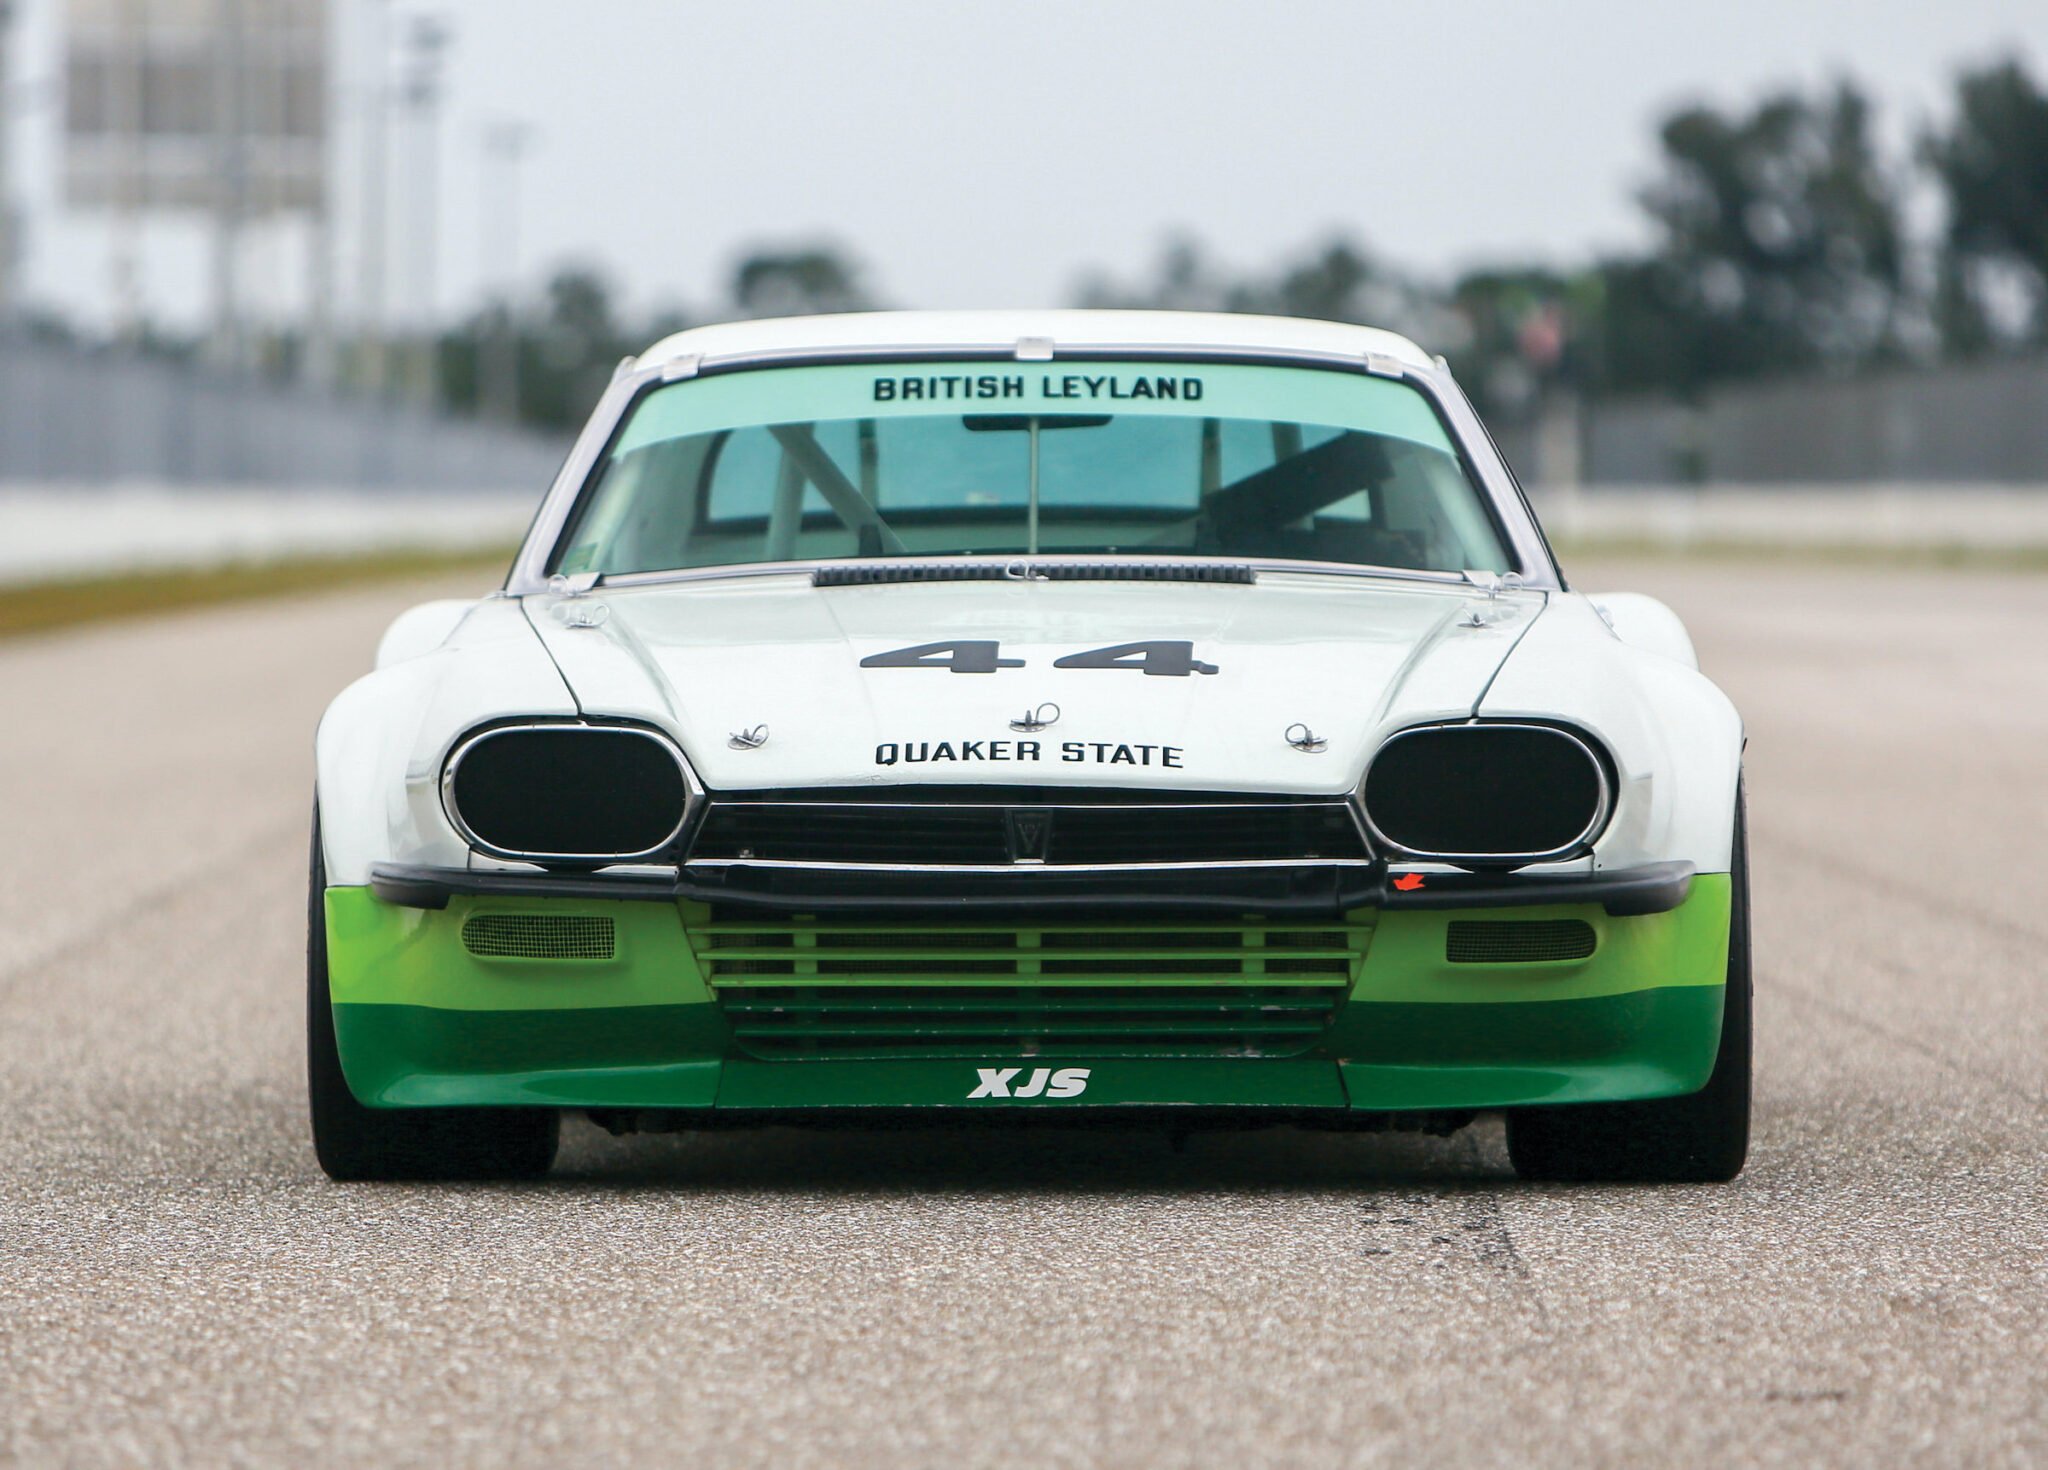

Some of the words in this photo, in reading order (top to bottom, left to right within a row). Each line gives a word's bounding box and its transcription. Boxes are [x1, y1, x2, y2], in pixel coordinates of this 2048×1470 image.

[873, 376, 1024, 401] BRITISH
[1042, 376, 1204, 401] LEYLAND
[859, 640, 1220, 677] 44
[875, 741, 1041, 766] QUAKER
[1061, 742, 1184, 769] STATE
[966, 1067, 1091, 1098] XJS
